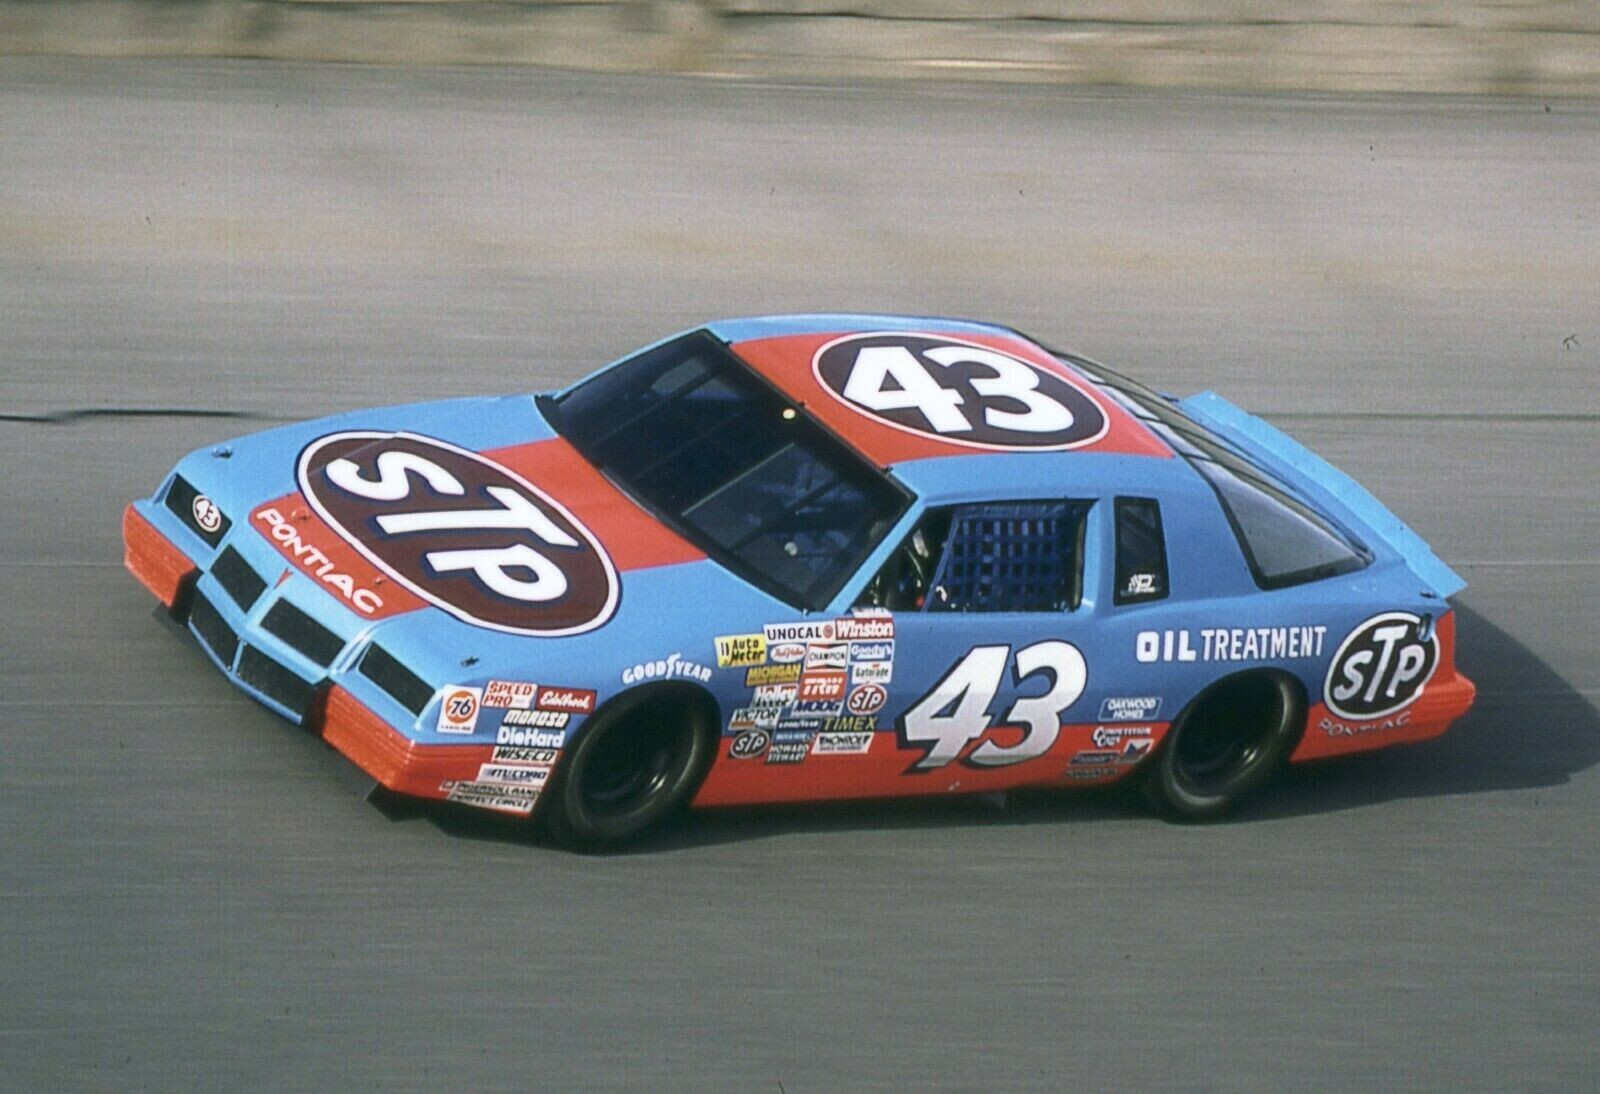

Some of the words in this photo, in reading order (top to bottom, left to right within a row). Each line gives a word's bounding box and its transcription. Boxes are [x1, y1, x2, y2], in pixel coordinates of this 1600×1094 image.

[843, 346, 1074, 433] 43
[195, 499, 219, 527] 43
[325, 450, 579, 603] STP
[256, 507, 385, 615] PONTIAC
[767, 625, 822, 641] UNOCAL
[836, 619, 894, 639] Winston
[732, 638, 760, 651] Auto
[1136, 630, 1197, 663] OIL
[1201, 626, 1327, 662] TREATMENT
[730, 650, 765, 664] Meter
[809, 651, 845, 662] CHAMPION
[1333, 624, 1426, 703] STP
[622, 652, 713, 684] GOODYEAR
[855, 667, 889, 678] Gatorade
[489, 684, 533, 696] SPEED
[803, 677, 843, 696] TRW
[451, 698, 472, 716] 76
[484, 695, 513, 706] PRO
[850, 687, 882, 710] STP
[903, 640, 1087, 768] 43
[824, 716, 878, 731] TIMEX
[496, 726, 565, 748] DieHard
[735, 731, 765, 752] STP
